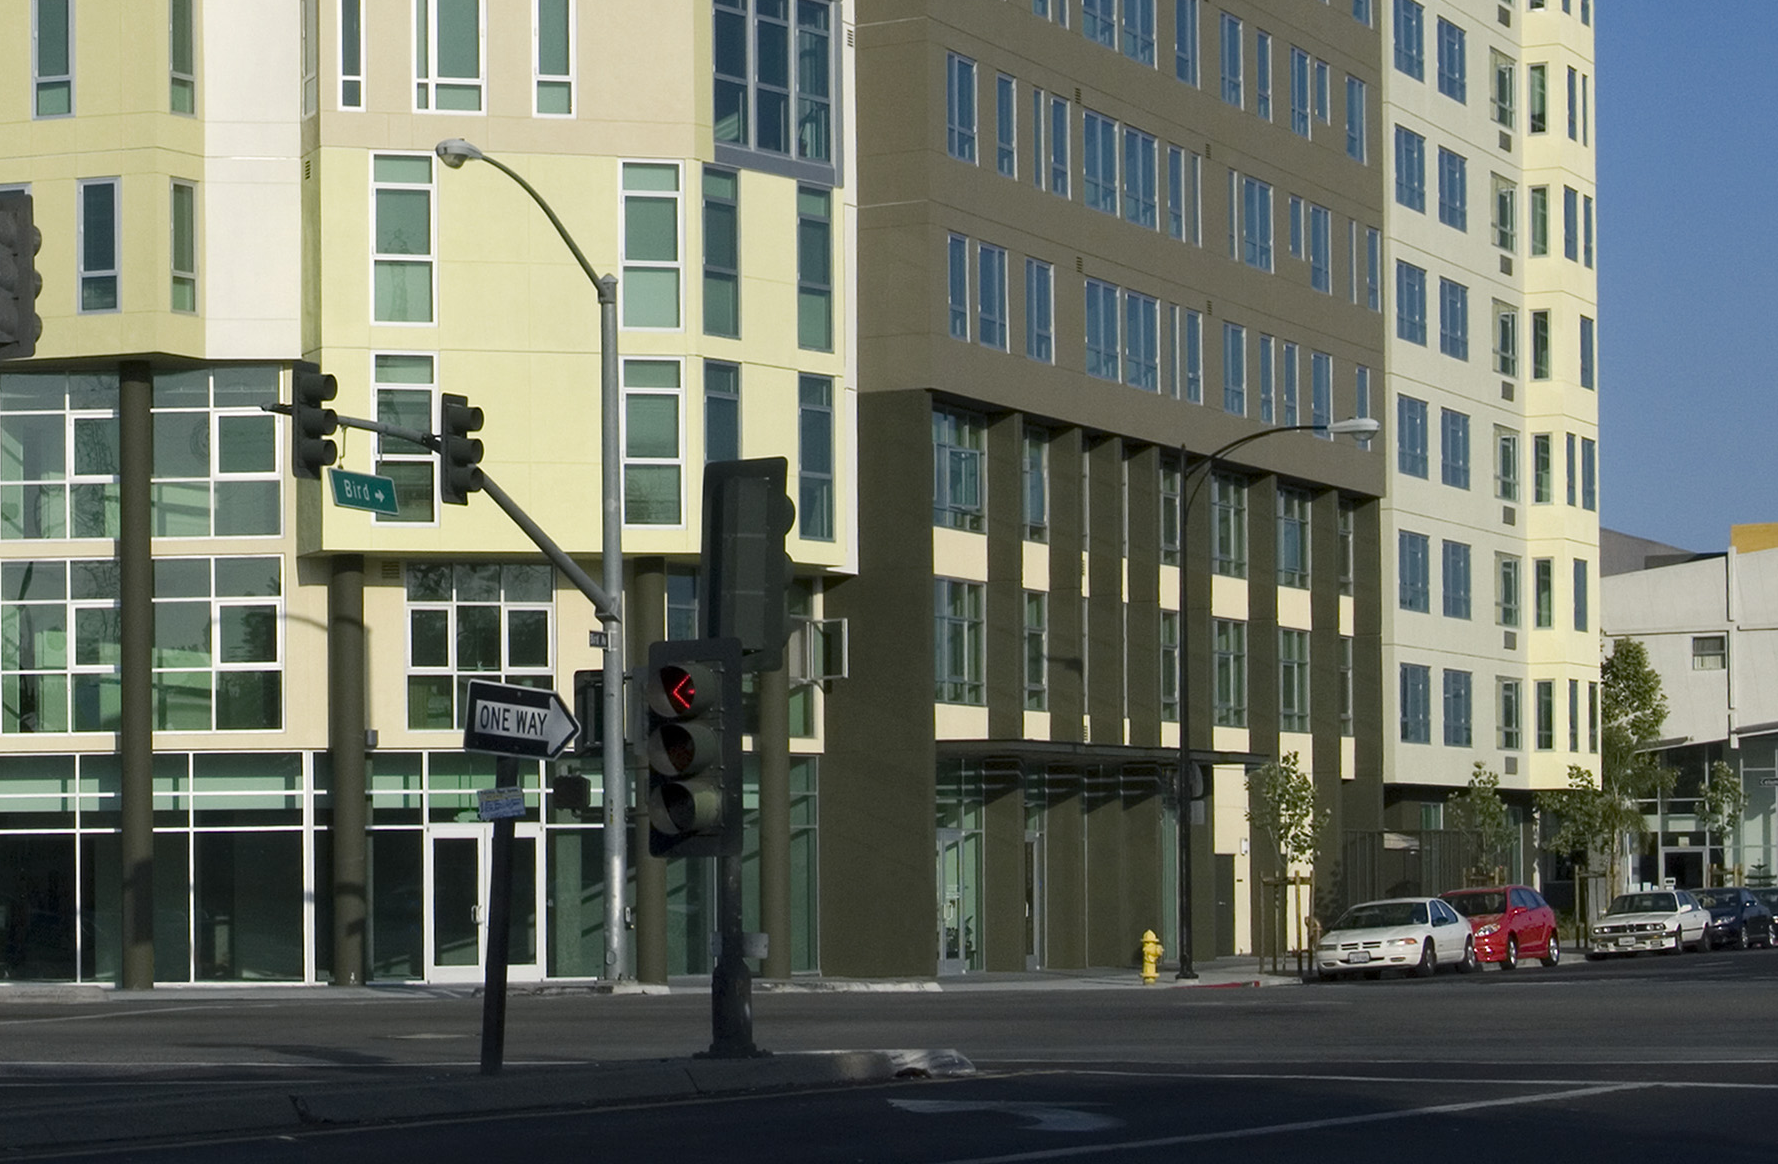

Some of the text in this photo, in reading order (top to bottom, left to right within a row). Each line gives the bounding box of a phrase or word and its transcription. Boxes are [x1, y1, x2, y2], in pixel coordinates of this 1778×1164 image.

[343, 479, 370, 501] Bird
[480, 705, 548, 736] ONE WAY
